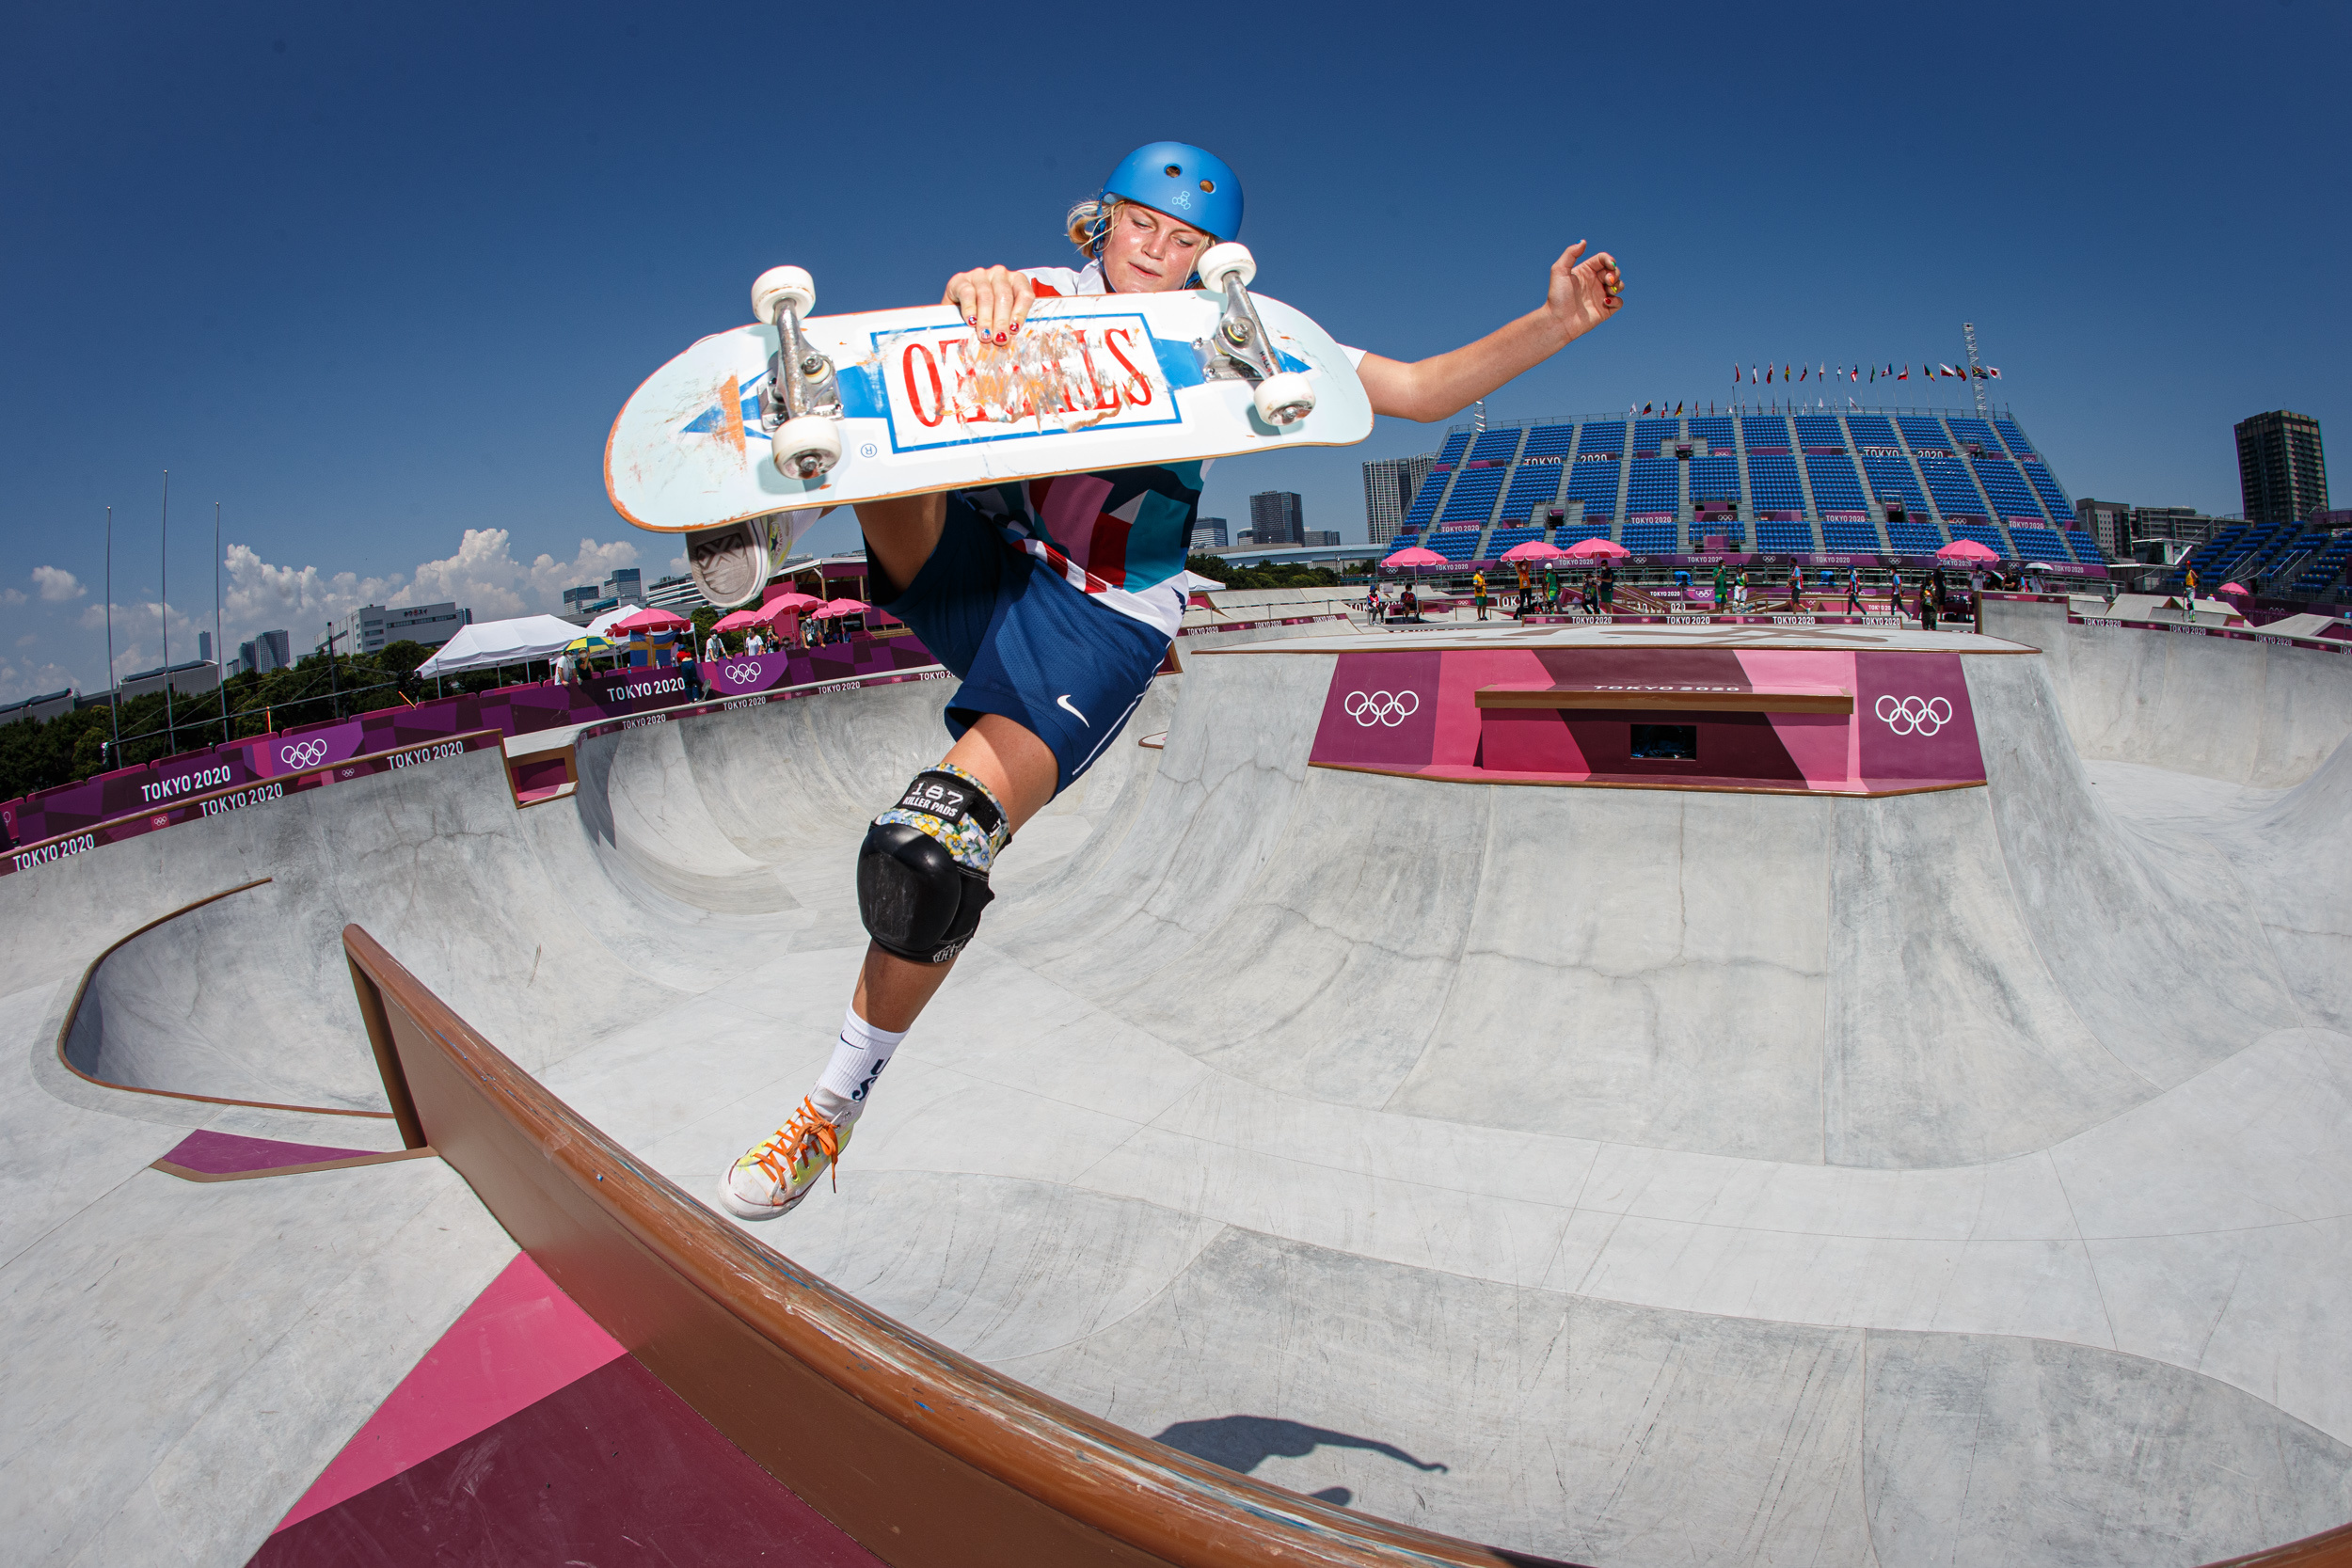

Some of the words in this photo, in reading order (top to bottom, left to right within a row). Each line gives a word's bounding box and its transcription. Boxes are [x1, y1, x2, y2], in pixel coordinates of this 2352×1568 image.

[1572, 616, 1595, 625] TOKYO
[1596, 616, 1613, 625] 2020
[1772, 616, 1795, 625] TOKYO
[1883, 617, 1900, 626] 2020
[2083, 617, 2105, 626] TOKYO
[2106, 619, 2122, 627] 2020
[1187, 627, 1205, 636] TOKYO
[2169, 625, 2190, 634] TOKYO
[2190, 626, 2206, 636] 2020
[2255, 634, 2276, 645] TOKYO
[2277, 637, 2292, 647] 2020
[919, 672, 945, 681] TOKYO
[607, 682, 652, 702] TOKYO
[653, 677, 685, 695] 2020
[818, 685, 841, 694] TOKYO
[841, 681, 860, 690] 2020
[723, 699, 747, 711] TOKYO
[748, 696, 766, 707] 2020
[623, 717, 646, 730] TOKYO
[646, 713, 666, 726] 2020
[387, 749, 431, 769] TOKYO
[433, 741, 464, 760] 2020
[141, 775, 191, 802] TOKYO
[194, 766, 231, 789] 2020
[199, 792, 247, 817] TOKYO
[249, 783, 283, 806] 2020
[912, 782, 964, 805] 187
[902, 796, 931, 809] KILLER
[930, 801, 958, 816] PADS
[13, 845, 58, 872] TOKYO
[60, 833, 94, 858] 2020
